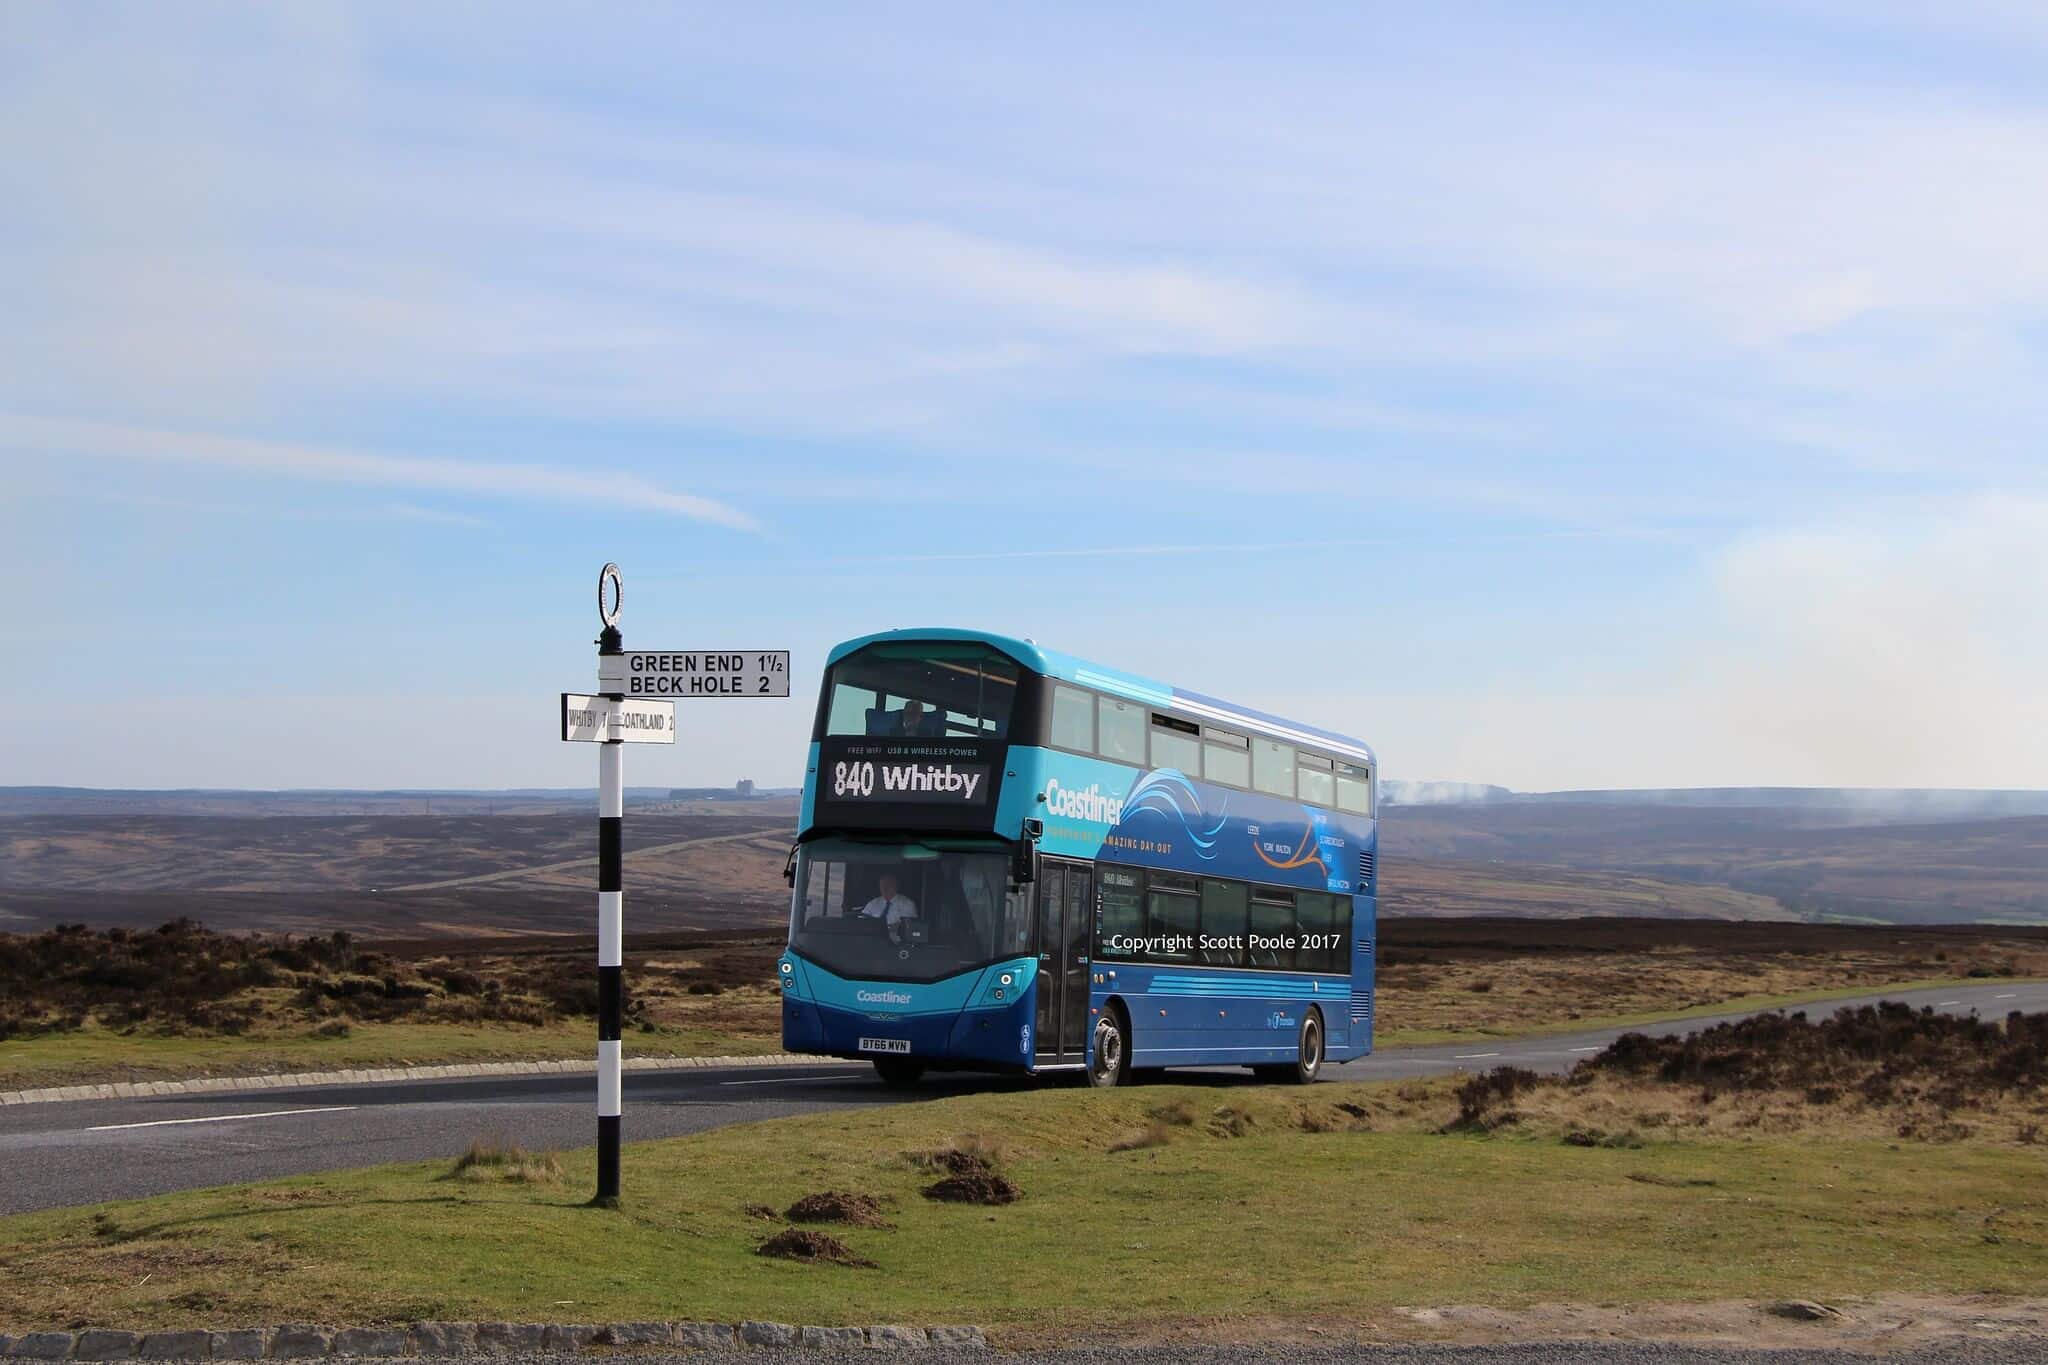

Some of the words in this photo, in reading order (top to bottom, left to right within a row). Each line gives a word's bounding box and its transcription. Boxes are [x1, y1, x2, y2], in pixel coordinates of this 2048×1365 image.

[630, 655, 697, 672] GREEN
[704, 655, 744, 672] END
[630, 676, 684, 693] BECK
[691, 676, 743, 693] HOLE
[759, 676, 770, 693] 2
[568, 709, 597, 728] WHITBY
[622, 712, 664, 731] OATHLAND
[669, 715, 674, 731] 2
[911, 747, 947, 755] WIRELESS
[949, 748, 977, 757] POWER
[834, 761, 874, 797] 840
[882, 763, 981, 800] Whitby
[1046, 778, 1123, 826] Coastliner
[1140, 840, 1154, 851] DAY
[1157, 843, 1172, 854] OUT
[857, 990, 912, 1004] Coastliner
[863, 1039, 887, 1050] BT66
